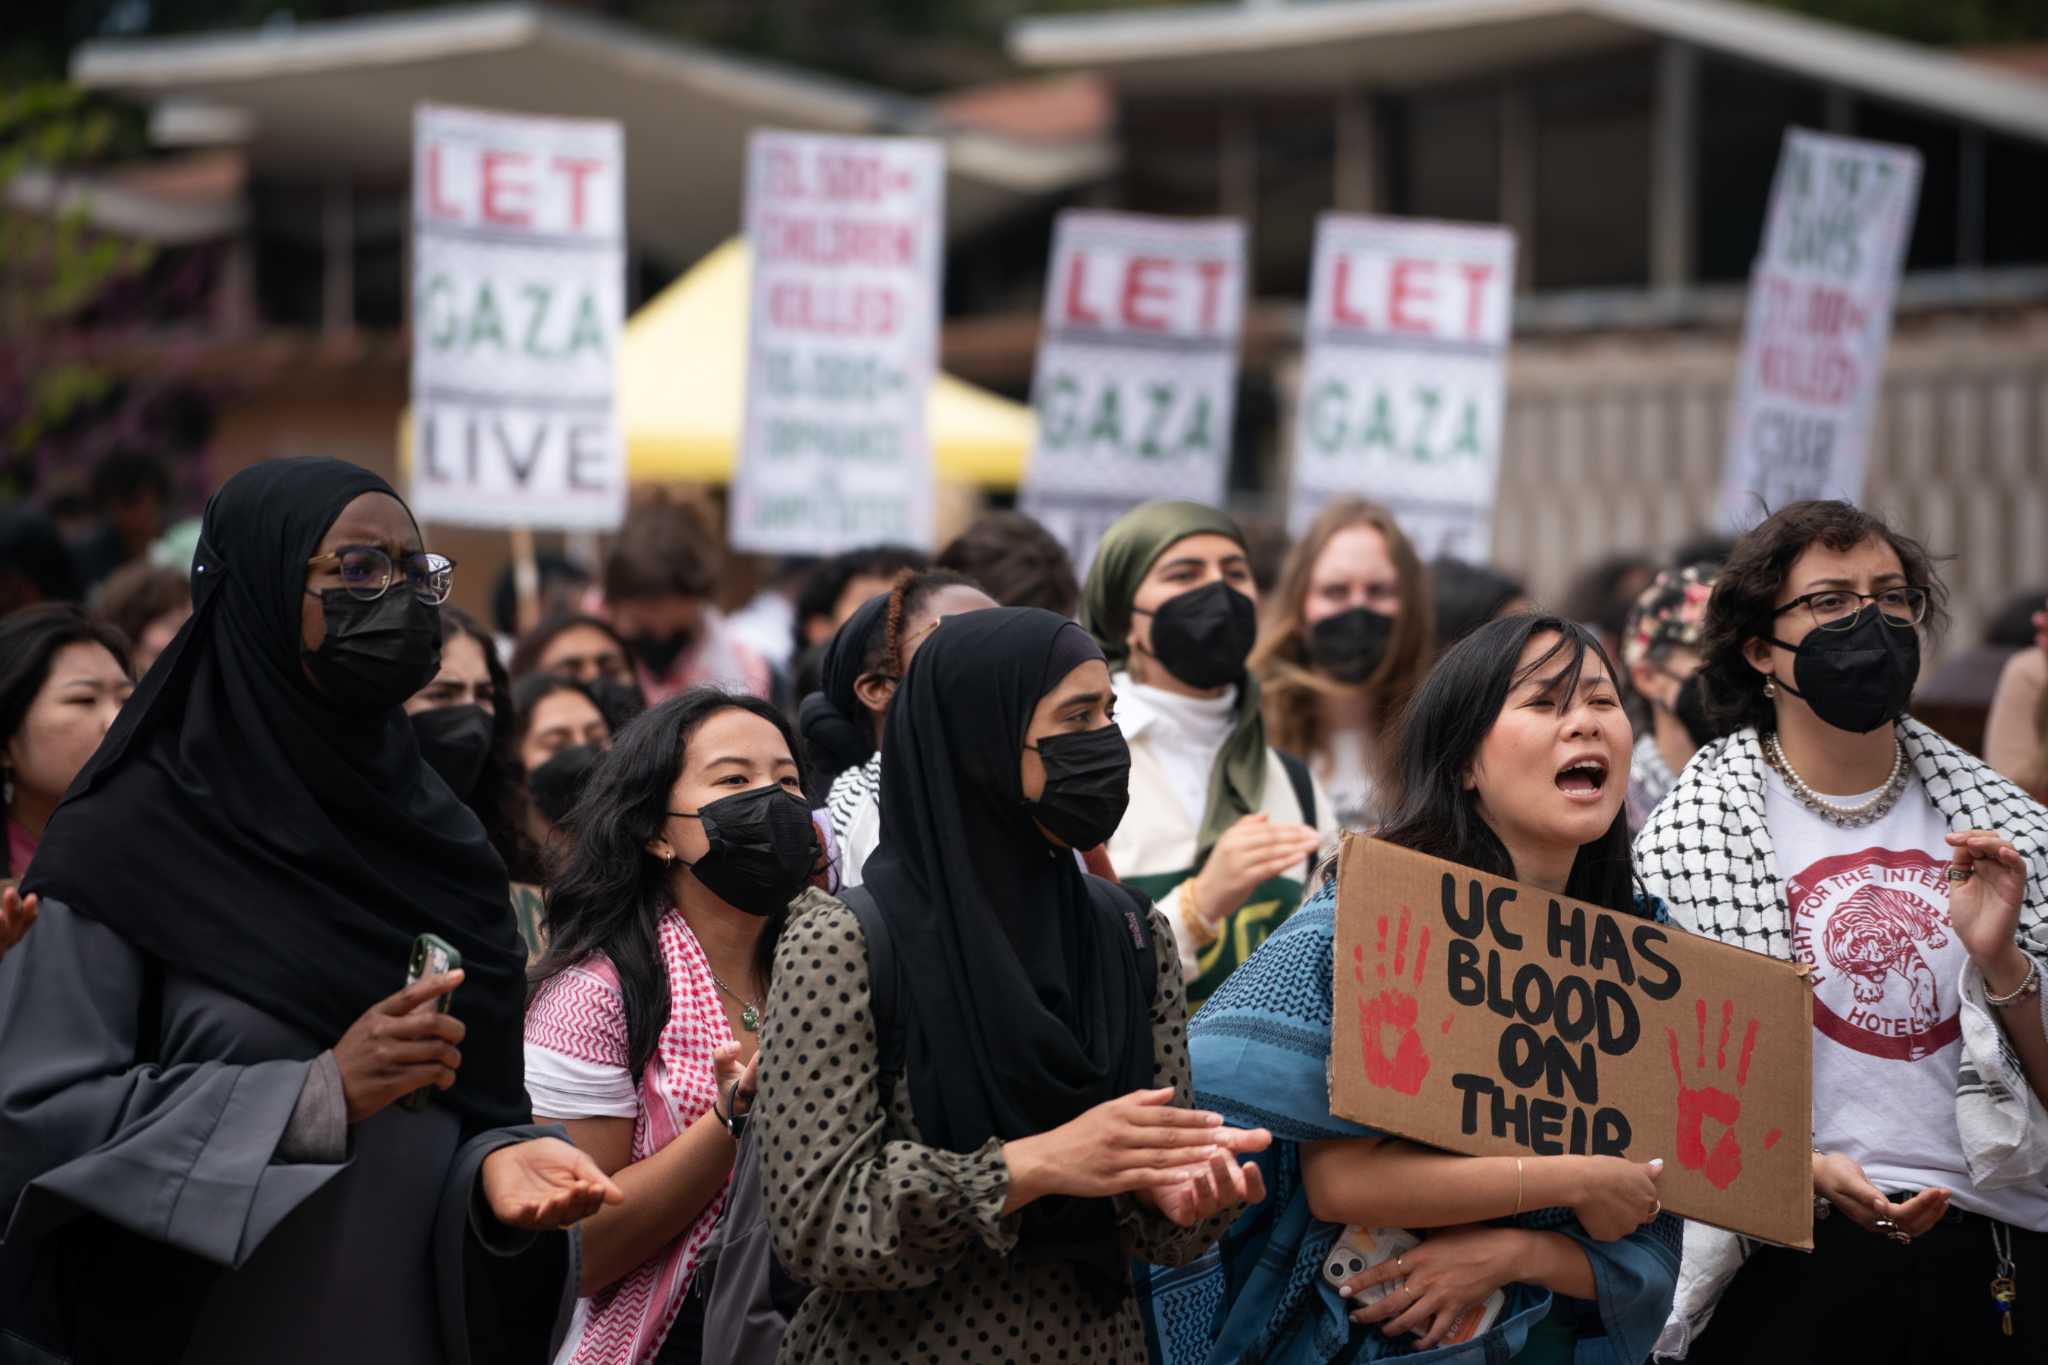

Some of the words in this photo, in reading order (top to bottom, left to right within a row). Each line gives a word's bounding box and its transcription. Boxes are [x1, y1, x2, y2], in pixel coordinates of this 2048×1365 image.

[424, 142, 605, 234] LET
[425, 274, 604, 359] GAZA
[1063, 251, 1231, 336] LET
[1329, 251, 1499, 340] LET
[422, 414, 609, 494] LIVE
[1039, 369, 1216, 458] GAZA
[1309, 378, 1484, 461] GAZA
[1799, 886, 1833, 919] FOR
[1830, 866, 1874, 891] THE
[1883, 868, 1950, 898] INTER
[1441, 873, 1523, 951] UC
[1546, 898, 1682, 1001] HAS
[1447, 938, 1641, 1056] BLOOD
[1847, 1006, 1924, 1036] HOTEL
[1498, 1023, 1599, 1106] ON
[1452, 1073, 1633, 1158] THEIR
